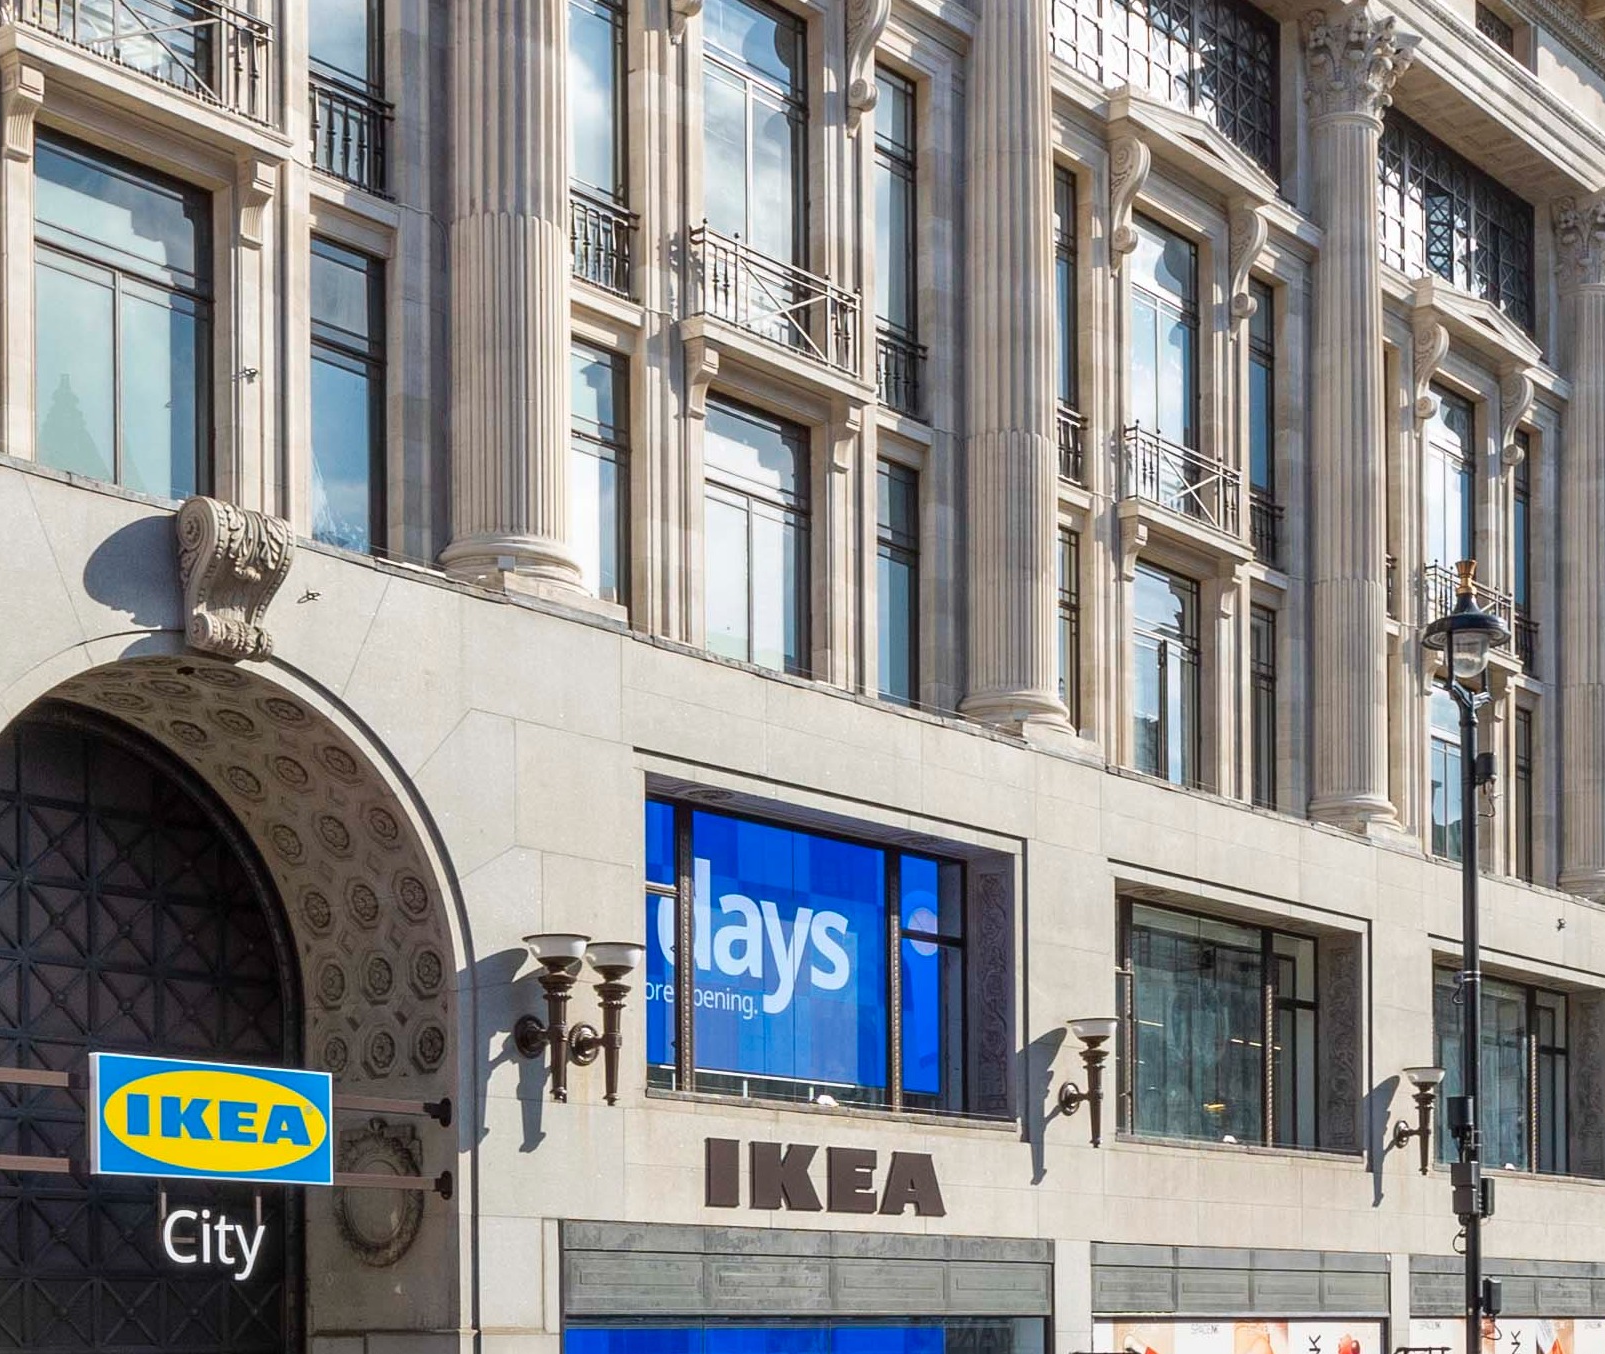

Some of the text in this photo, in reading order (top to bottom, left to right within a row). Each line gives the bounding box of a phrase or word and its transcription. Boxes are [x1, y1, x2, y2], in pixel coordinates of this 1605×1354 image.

[657, 858, 851, 1015] days
[126, 1093, 311, 1147] IKEA
[704, 1137, 946, 1217] IKEA
[162, 1209, 266, 1282] City
